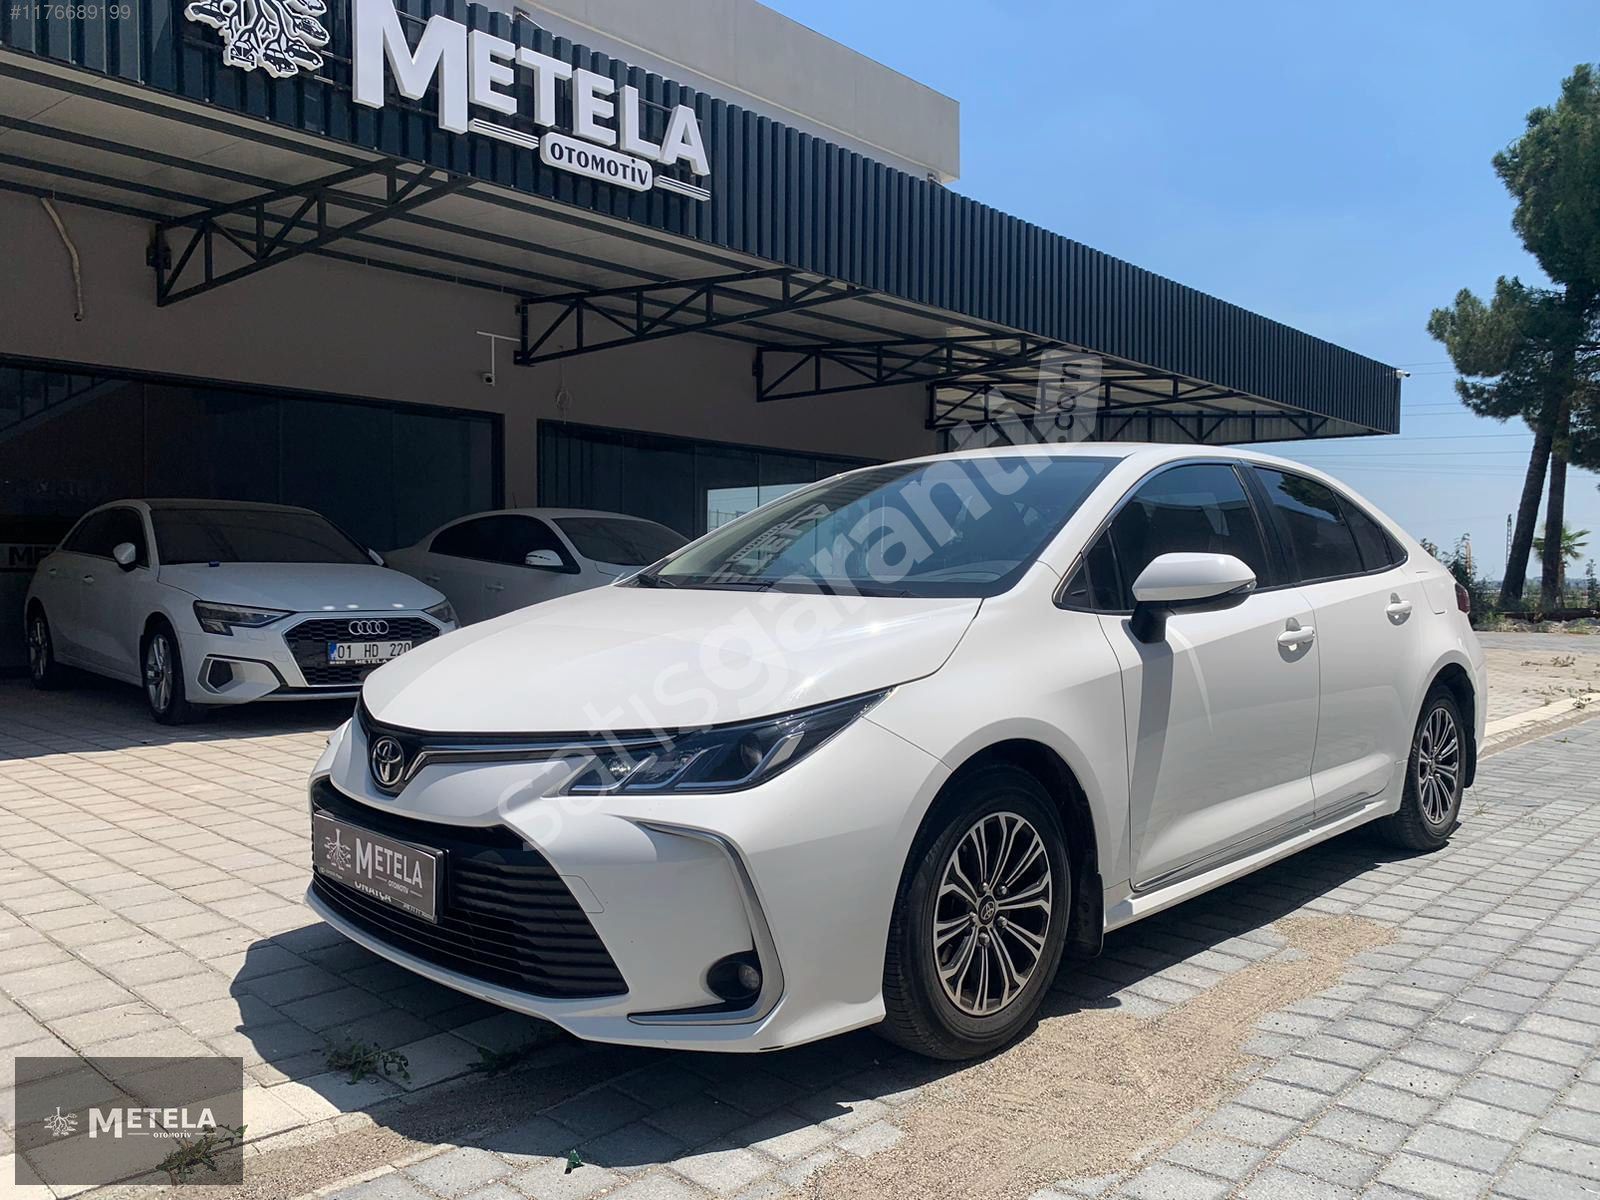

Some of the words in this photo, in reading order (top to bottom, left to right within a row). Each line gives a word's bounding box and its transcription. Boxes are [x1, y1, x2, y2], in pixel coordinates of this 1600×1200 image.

[352, 0, 711, 176] METELA
[550, 142, 650, 186] OTOMOTİV
[337, 645, 352, 659] 01
[364, 643, 379, 658] HD
[356, 838, 423, 889] METELA
